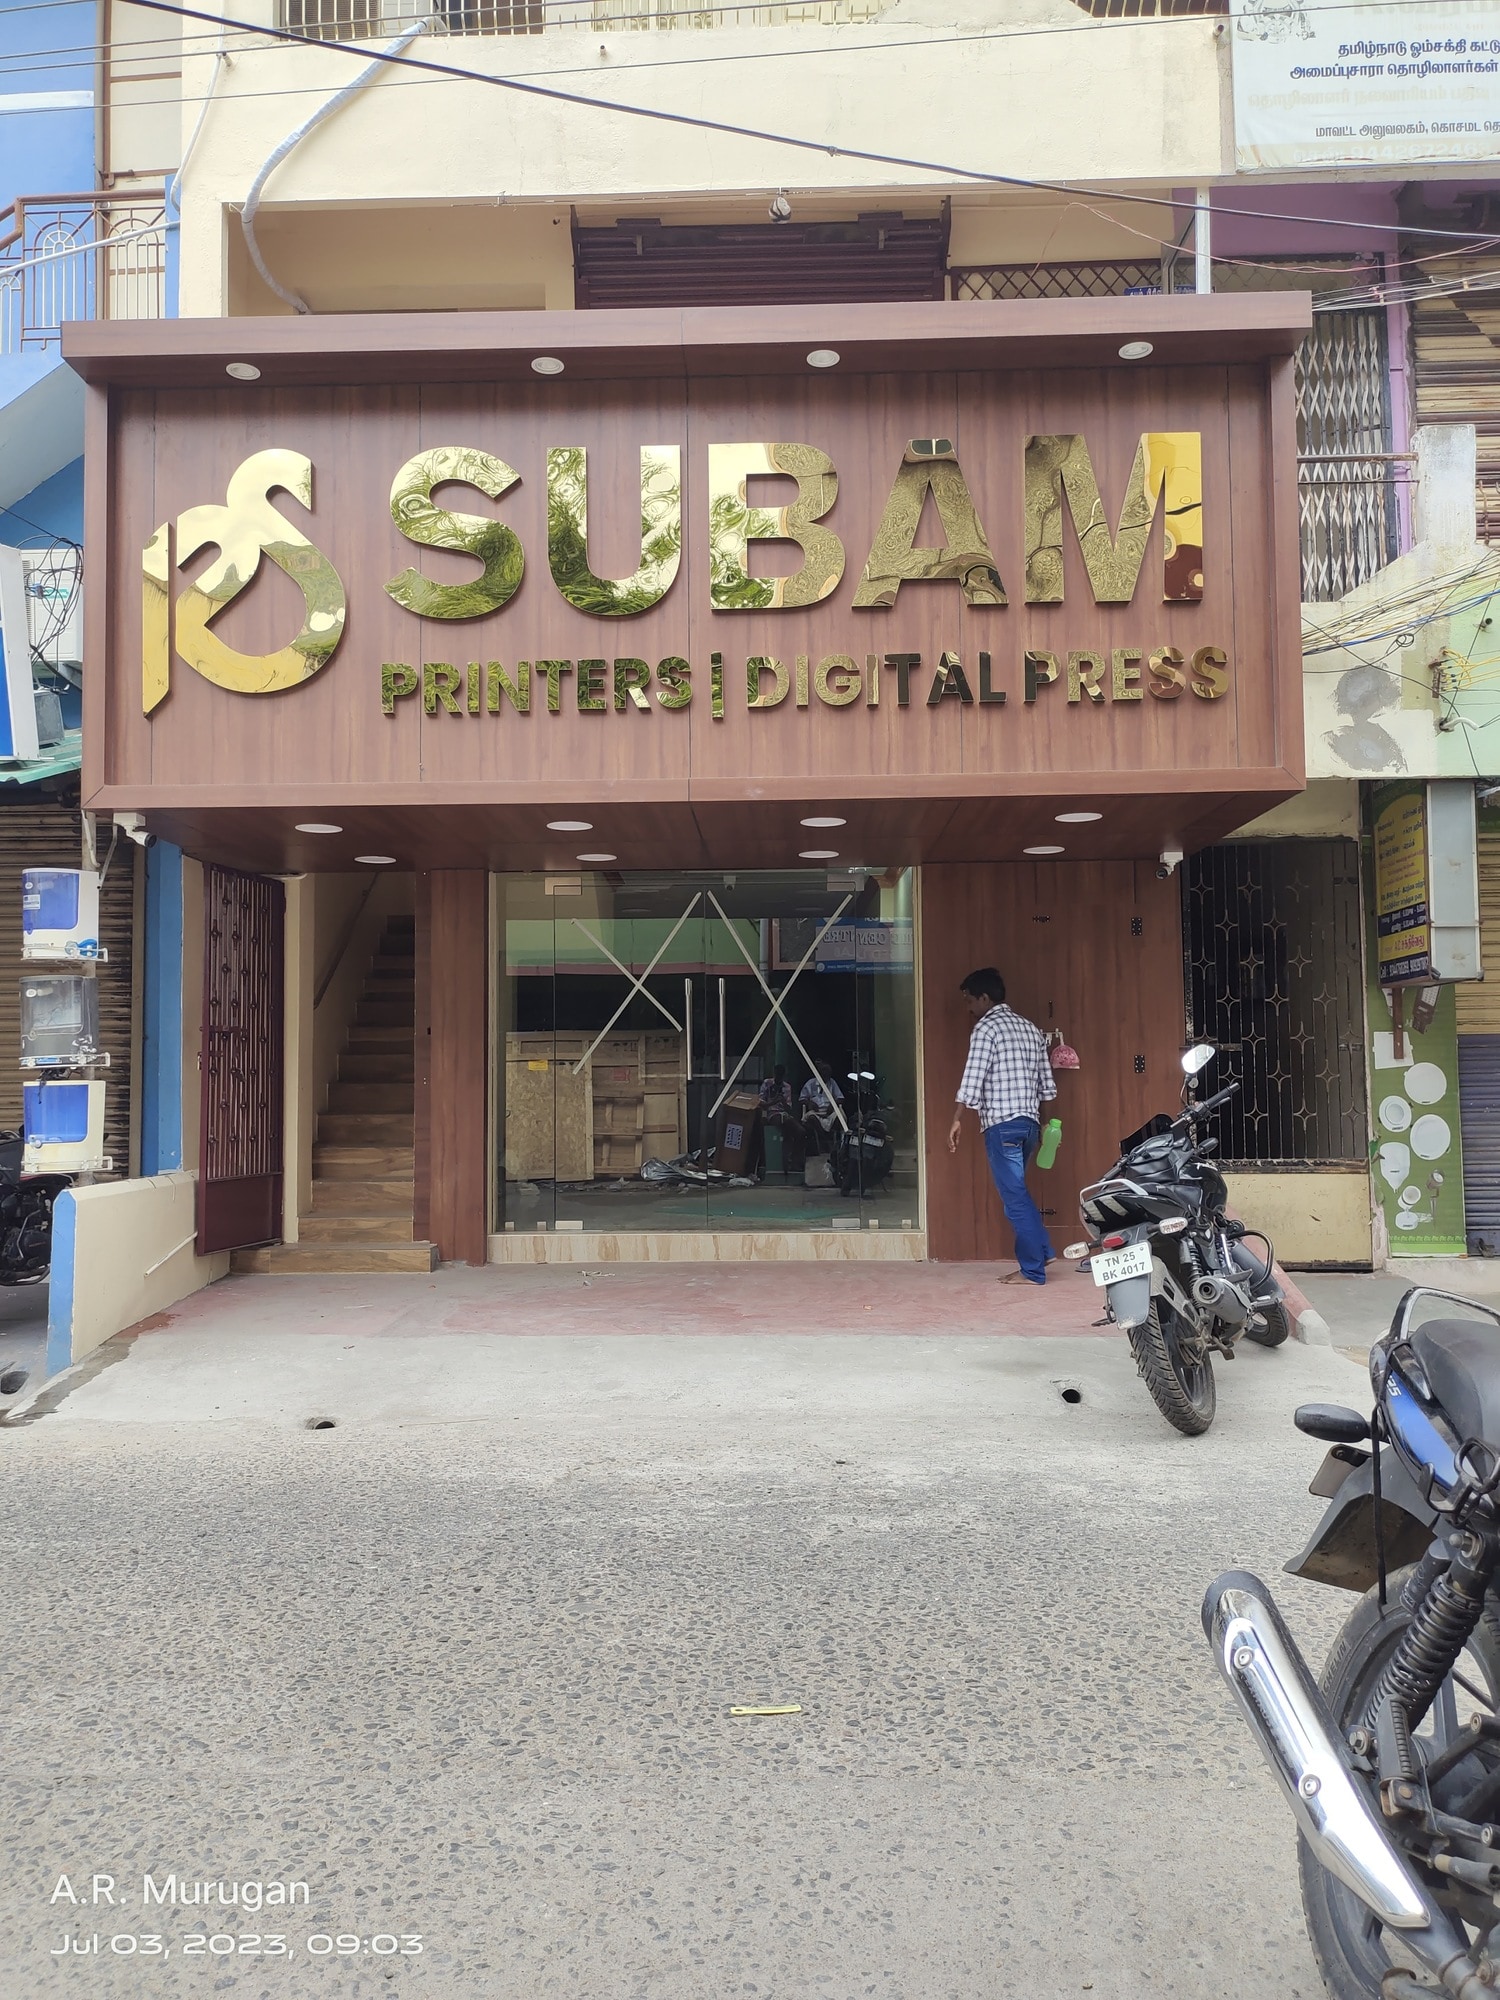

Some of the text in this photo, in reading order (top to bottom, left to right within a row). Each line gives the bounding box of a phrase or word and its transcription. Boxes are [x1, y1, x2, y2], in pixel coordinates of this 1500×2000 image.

[1338, 41, 1407, 59] தமிழ்நாடு
[1410, 39, 1466, 58] ஓம்சக்தி
[1290, 59, 1499, 79] அமைப்புசாரா தொழிலாளர்கள்
[1315, 125, 1356, 137] மாவட்ட
[382, 431, 1204, 620] SUBAM
[381, 656, 693, 717] PRINTERS
[746, 651, 1007, 709] DIGITAL
[1023, 645, 1229, 705] PRESS
[1105, 1251, 1136, 1267] TN 25
[1103, 1261, 1145, 1281] BK 4017
